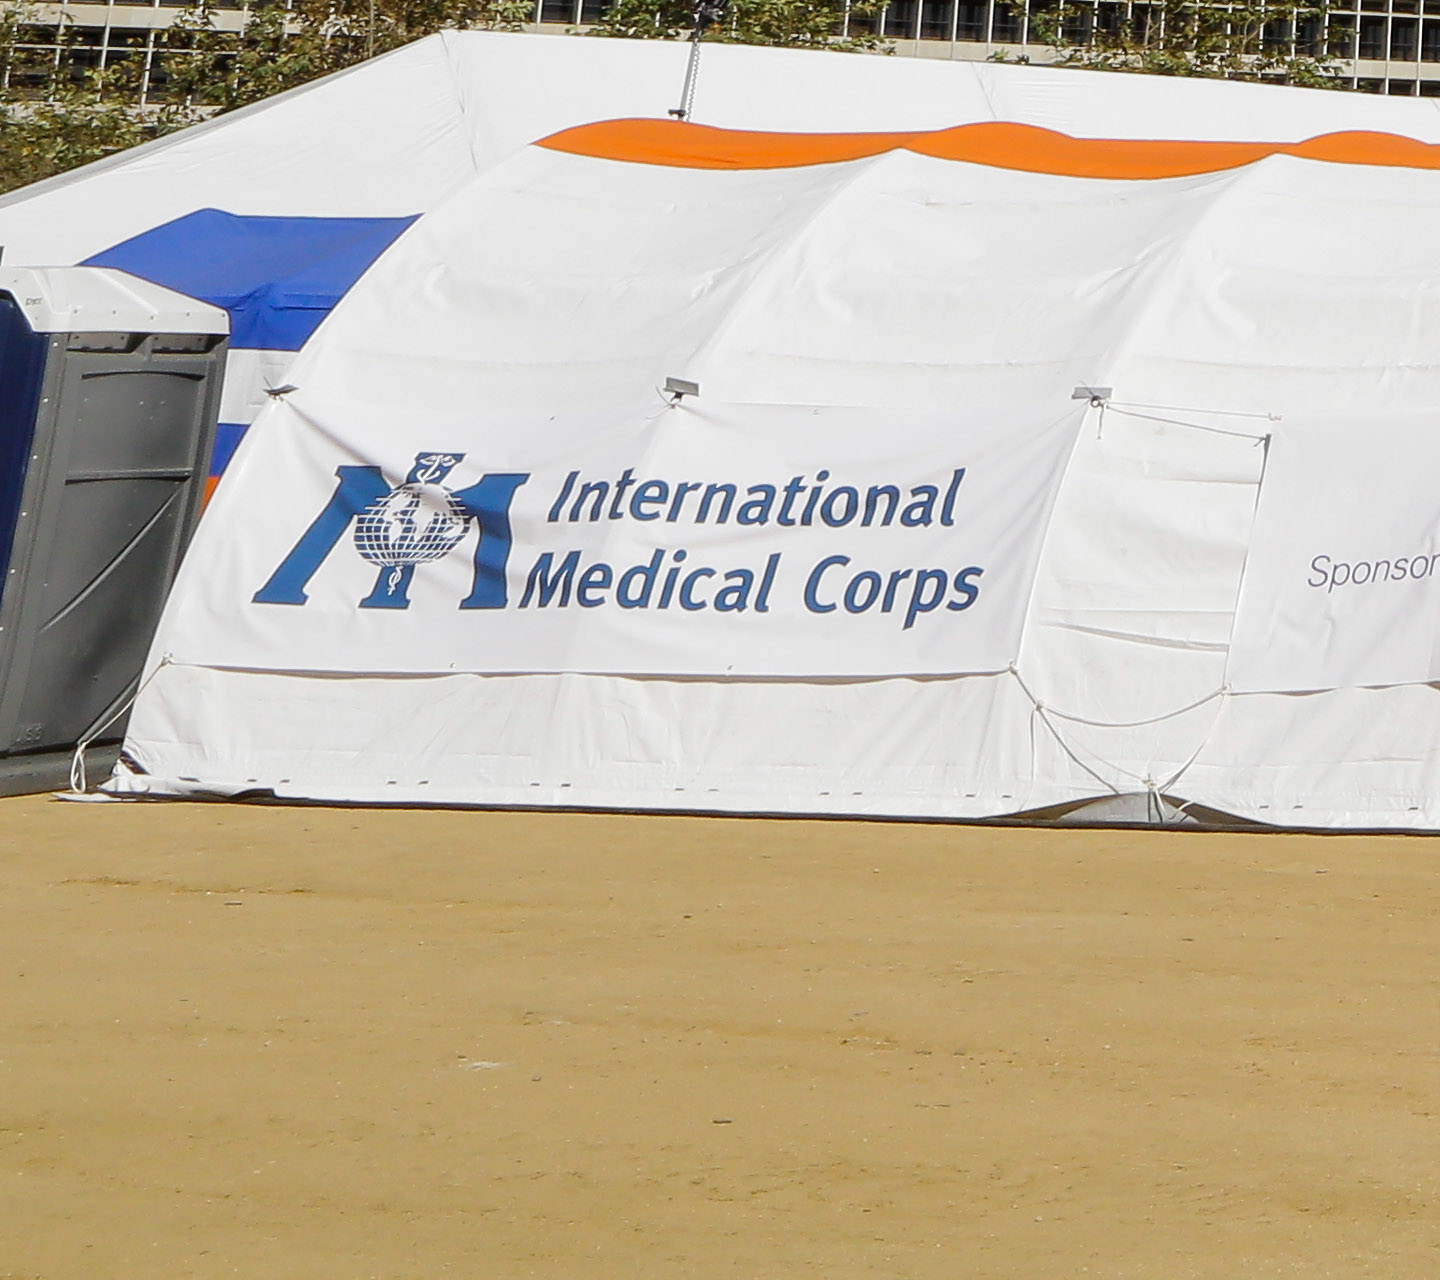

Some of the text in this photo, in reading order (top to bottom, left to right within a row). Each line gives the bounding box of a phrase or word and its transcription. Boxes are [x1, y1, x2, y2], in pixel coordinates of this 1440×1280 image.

[547, 468, 966, 528] International
[518, 547, 983, 630] Medical Corps
